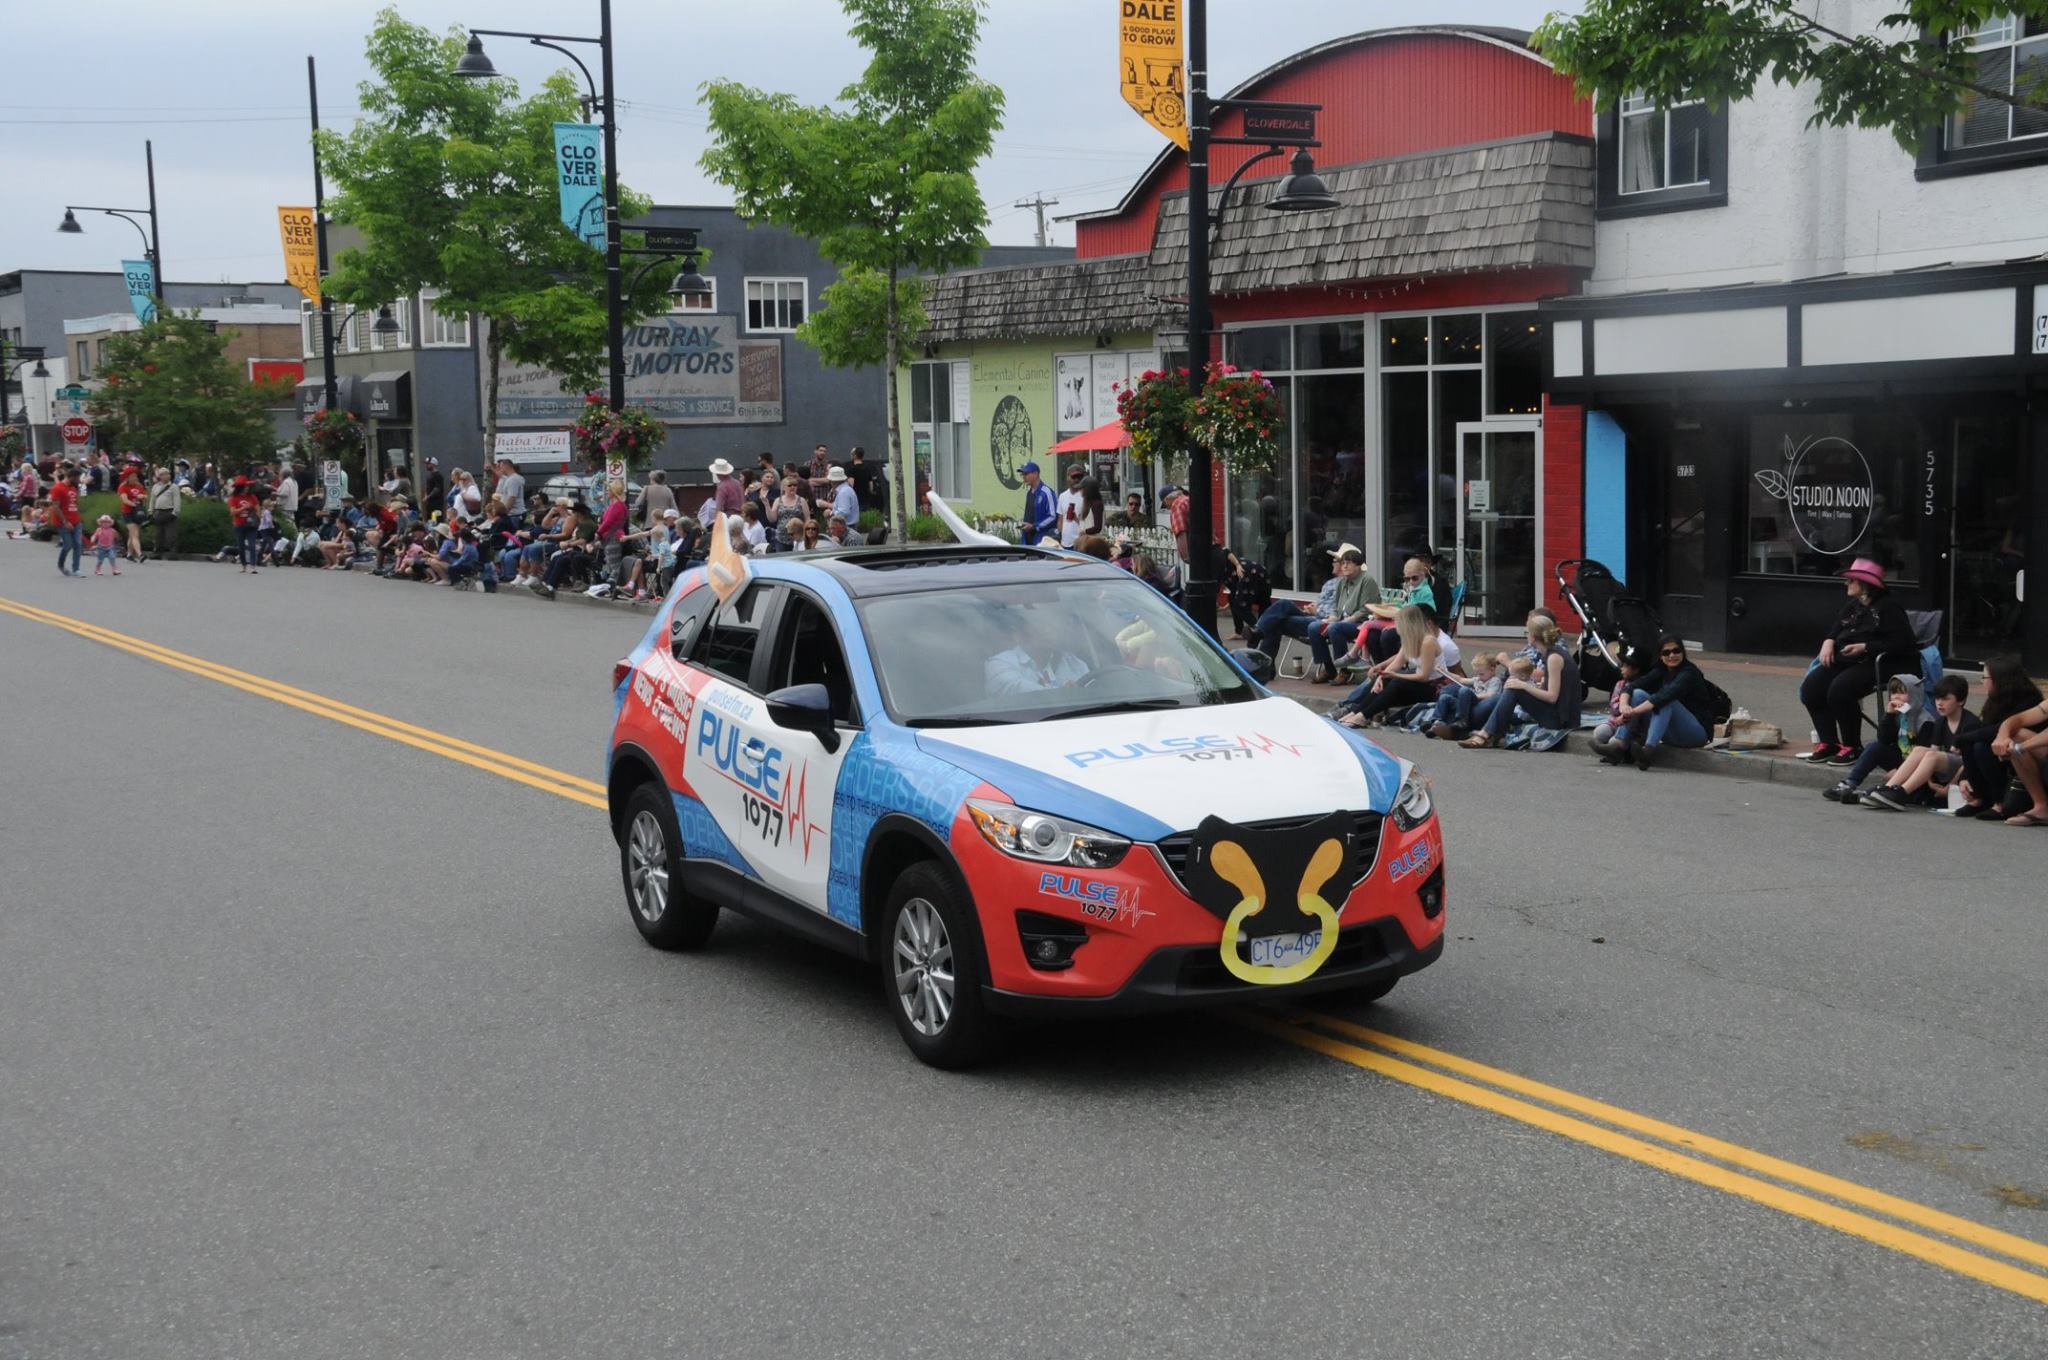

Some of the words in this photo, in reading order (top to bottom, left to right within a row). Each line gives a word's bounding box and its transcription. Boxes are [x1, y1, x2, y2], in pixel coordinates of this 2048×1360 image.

[1123, 1, 1175, 21] DALE
[1123, 33, 1137, 42] TO
[1141, 34, 1176, 45] GROW
[1248, 118, 1311, 130] CLOVERDALE
[561, 145, 596, 160] CLO
[562, 161, 597, 175] VER
[562, 175, 597, 186] DALE
[283, 215, 311, 225] CLO
[284, 226, 312, 237] VER
[286, 237, 313, 246] DALE
[127, 272, 150, 281] CLO
[128, 281, 151, 290] VER
[623, 325, 720, 347] MURRAY
[632, 352, 734, 375] MOTORS
[696, 400, 733, 413] SERVICE
[64, 425, 89, 437] STOP
[495, 434, 530, 446] haba
[536, 434, 566, 446] Thai
[1925, 450, 1935, 515] 5735
[1792, 486, 1833, 507] STUDIO
[1836, 487, 1870, 507] NOON
[633, 669, 655, 708] NEWS
[667, 678, 694, 721] MUSIC
[698, 709, 783, 801] PULSE
[1064, 734, 1237, 769] PULSE
[1179, 748, 1254, 762] 107.7
[743, 792, 783, 848] 107.7
[1388, 839, 1428, 880] PULSE
[1039, 871, 1120, 905] PULSE
[1081, 902, 1118, 921] 107.7
[1252, 937, 1285, 962] CT6
